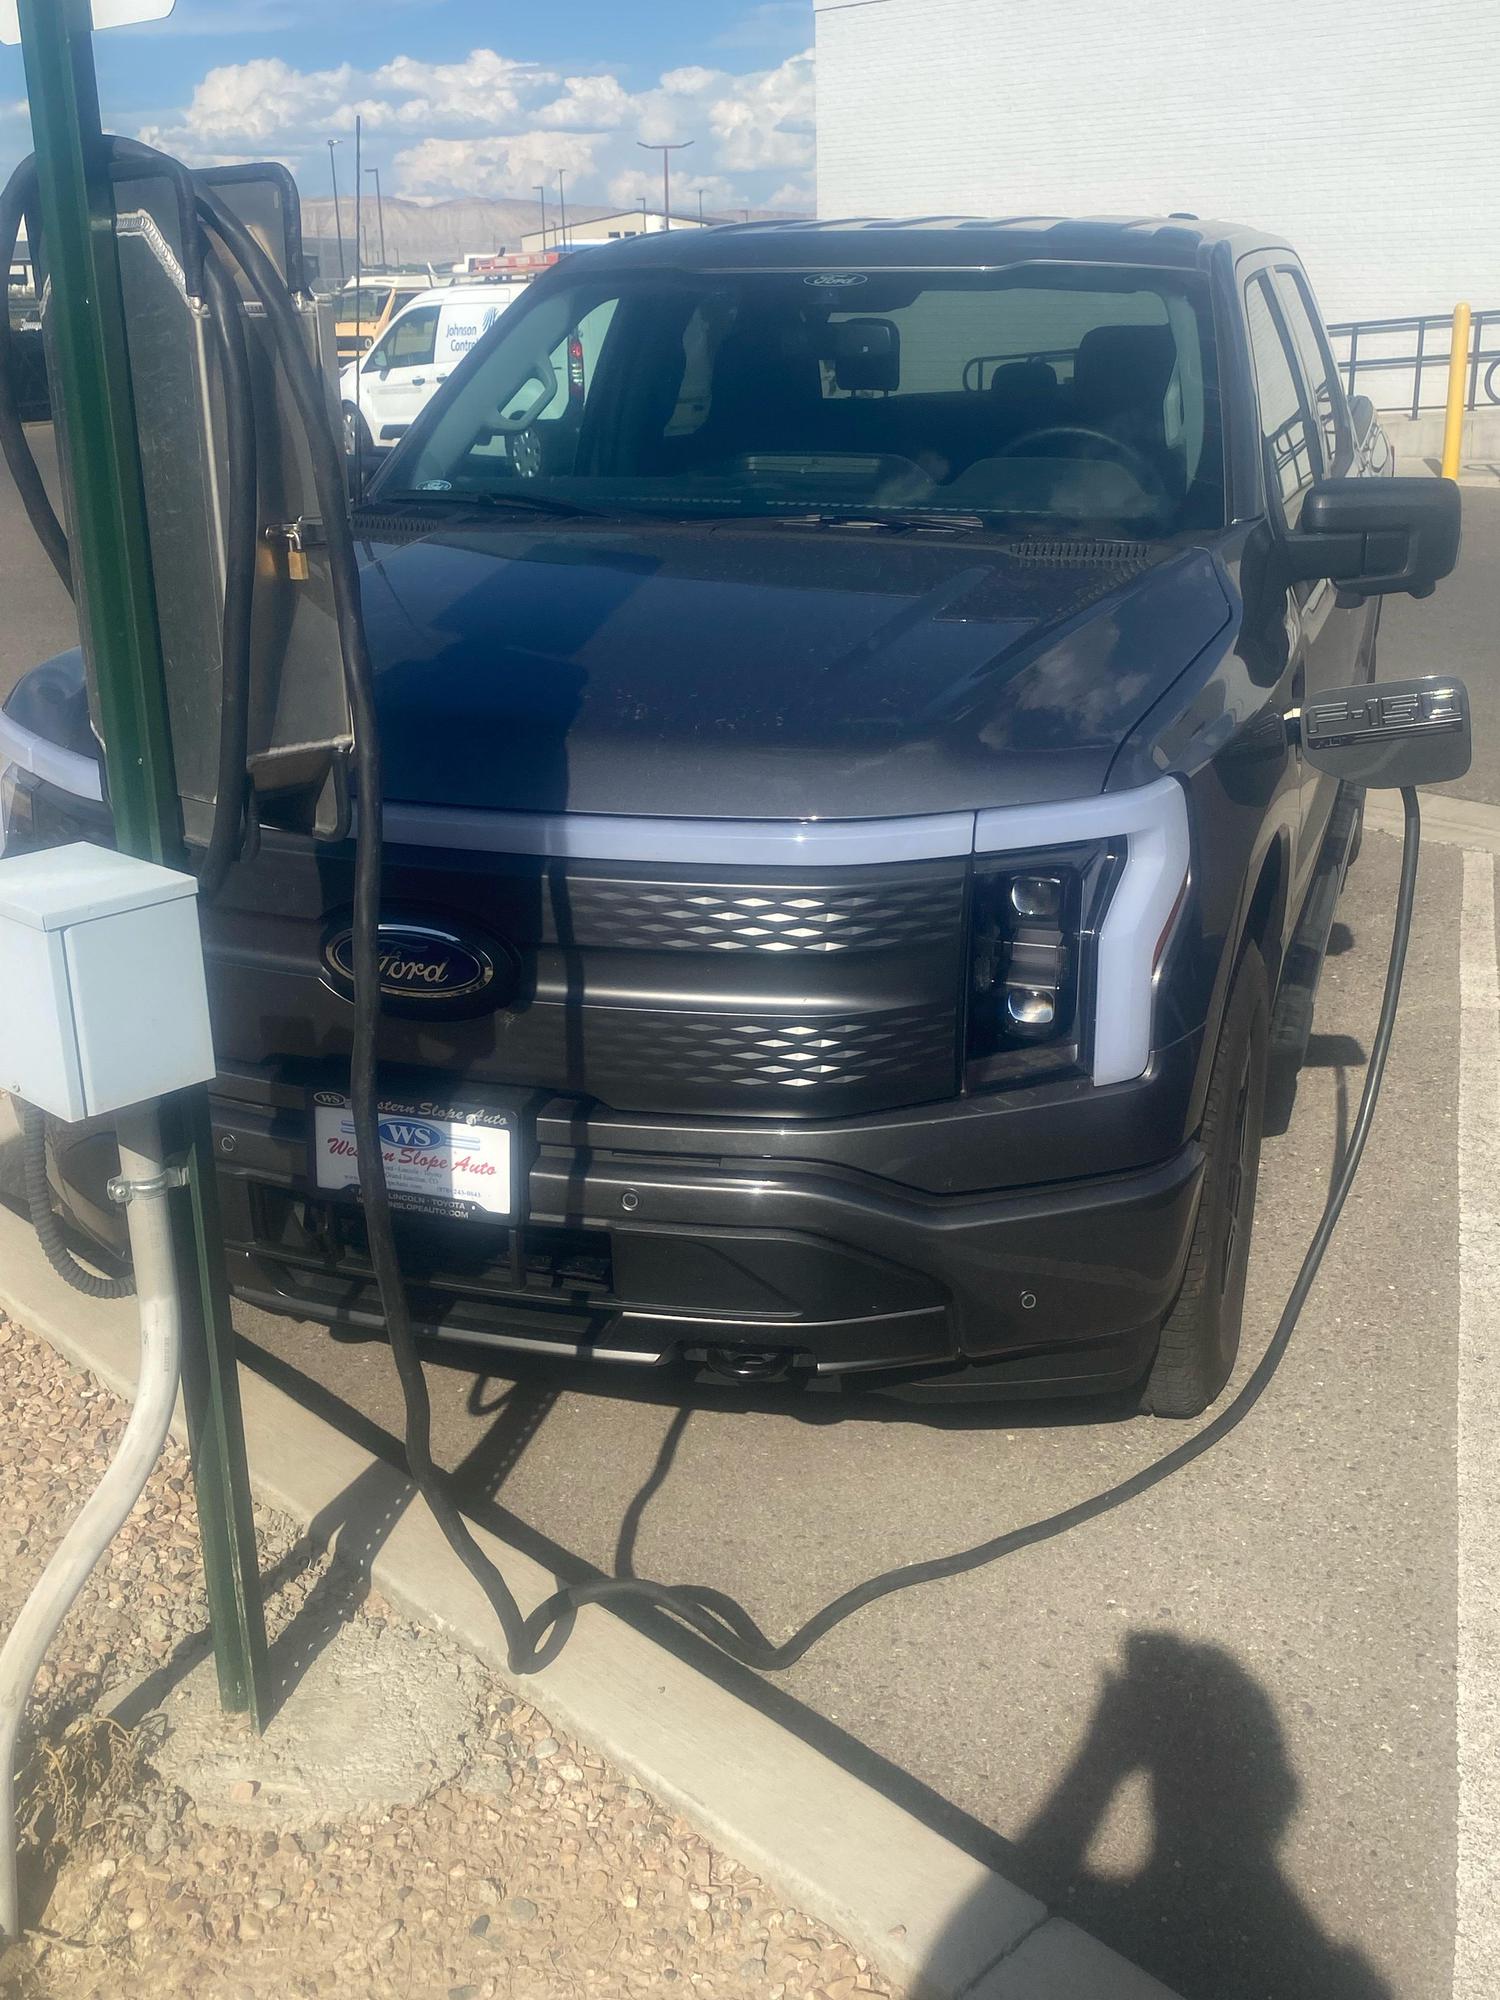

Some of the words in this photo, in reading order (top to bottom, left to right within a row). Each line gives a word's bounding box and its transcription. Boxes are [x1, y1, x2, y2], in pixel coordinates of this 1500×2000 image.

[814, 273, 857, 284] Ford
[446, 324, 477, 337] Johnson
[1306, 688, 1461, 733] F-150
[320, 1094, 340, 1104] WS
[377, 1100, 415, 1114] stern
[417, 1102, 464, 1121] Slope
[466, 1109, 508, 1126] Auto
[386, 1124, 431, 1147] WS
[398, 1148, 448, 1172] Slope
[451, 1155, 497, 1176] Auto
[388, 1192, 425, 1204] LINCOLN
[432, 1198, 466, 1210] TOYOTA
